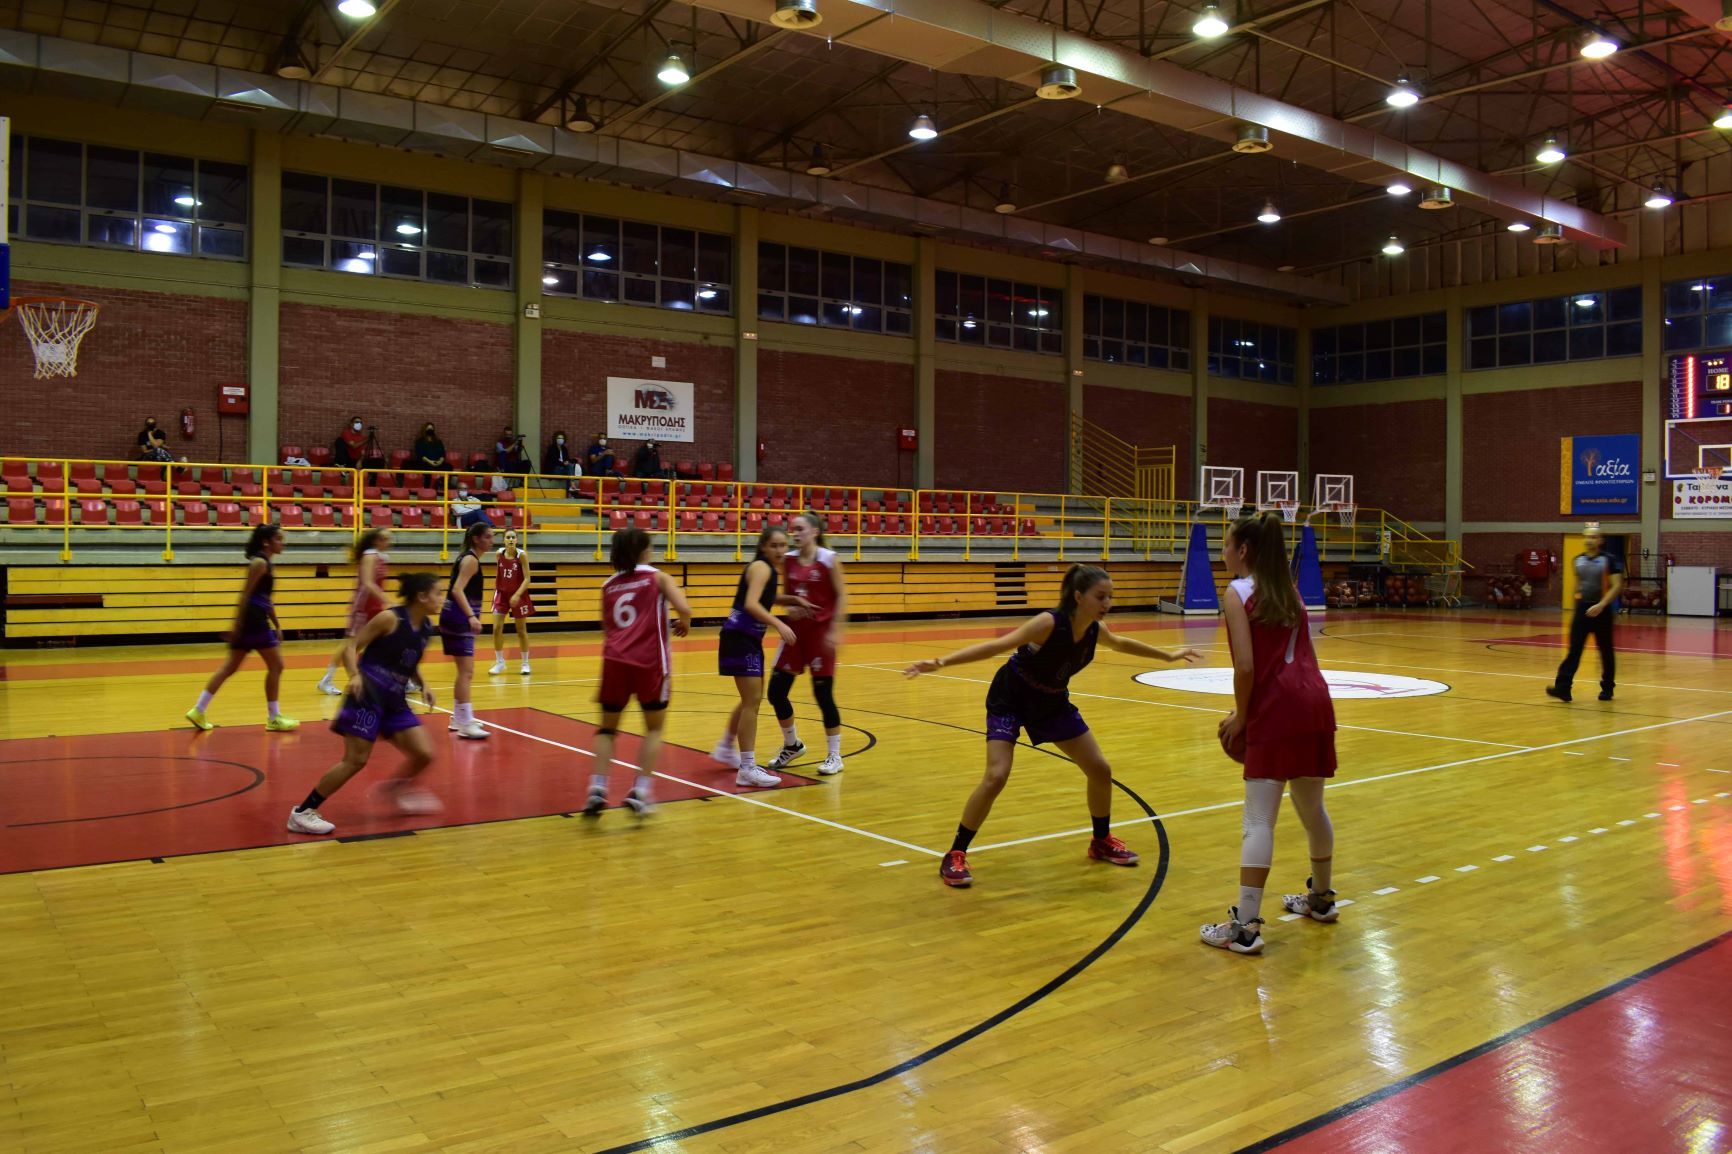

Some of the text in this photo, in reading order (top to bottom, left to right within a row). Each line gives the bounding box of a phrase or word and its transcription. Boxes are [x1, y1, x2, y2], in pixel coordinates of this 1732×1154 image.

[1716, 374, 1730, 390] 18
[618, 414, 685, 427] ΜΑΚΡΥΠΟΔΗΣ
[1595, 457, 1631, 479] αξία
[1687, 483, 1729, 493] Τανα
[1688, 495, 1732, 504] ΚΟΡΟΜ
[503, 568, 513, 579] 13
[519, 604, 529, 616] 13
[612, 592, 637, 629] 6
[355, 707, 377, 730] 10
